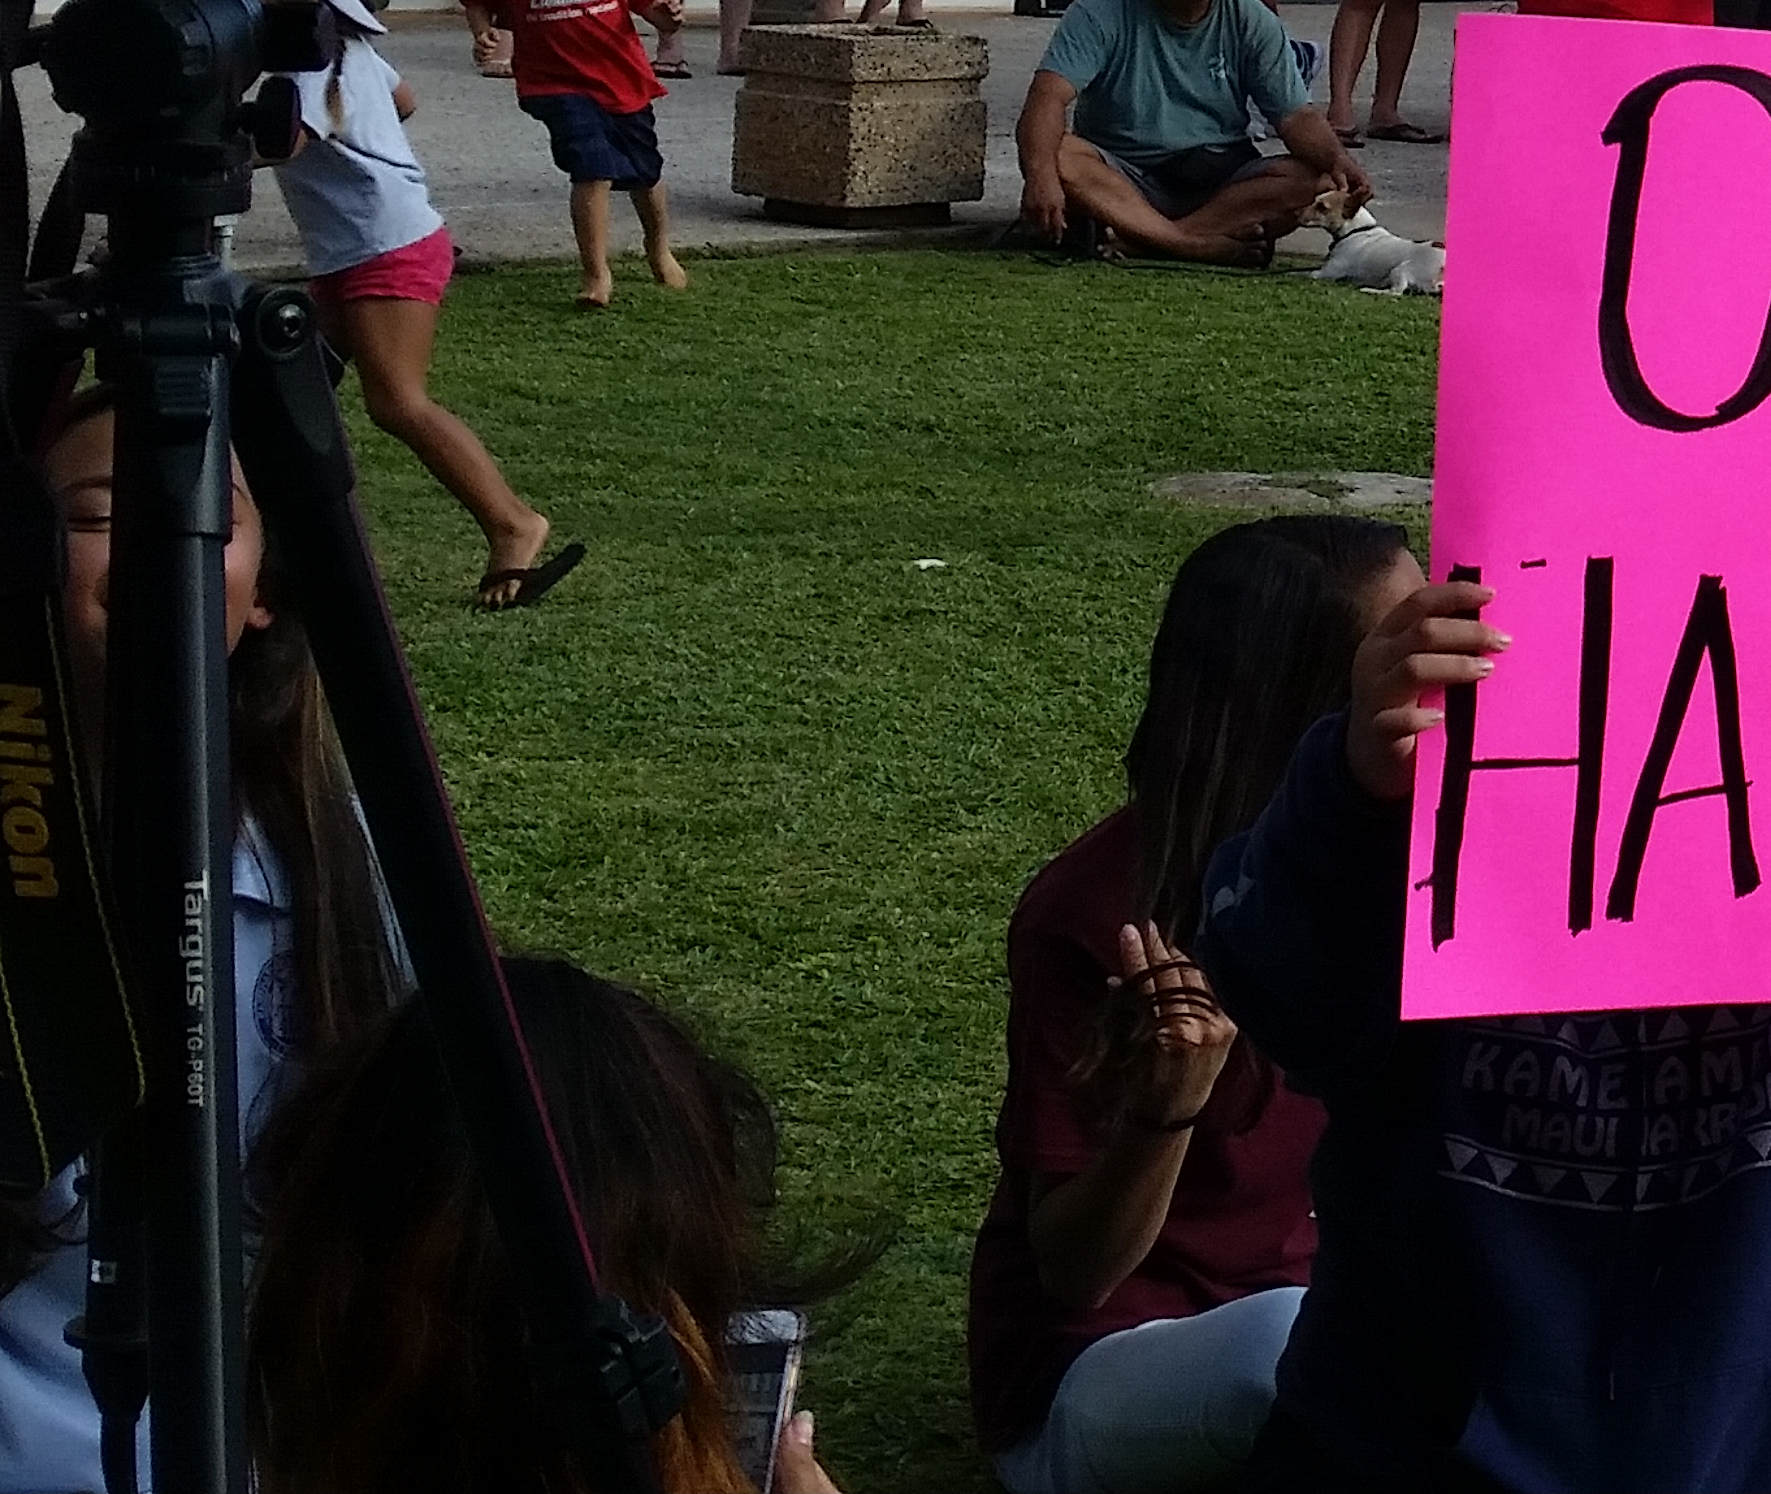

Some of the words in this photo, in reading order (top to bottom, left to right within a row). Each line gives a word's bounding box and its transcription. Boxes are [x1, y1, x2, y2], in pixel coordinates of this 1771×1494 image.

[0, 683, 59, 899] Nikon
[178, 869, 209, 1011] Targus
[1501, 1103, 1621, 1159] MAUI
